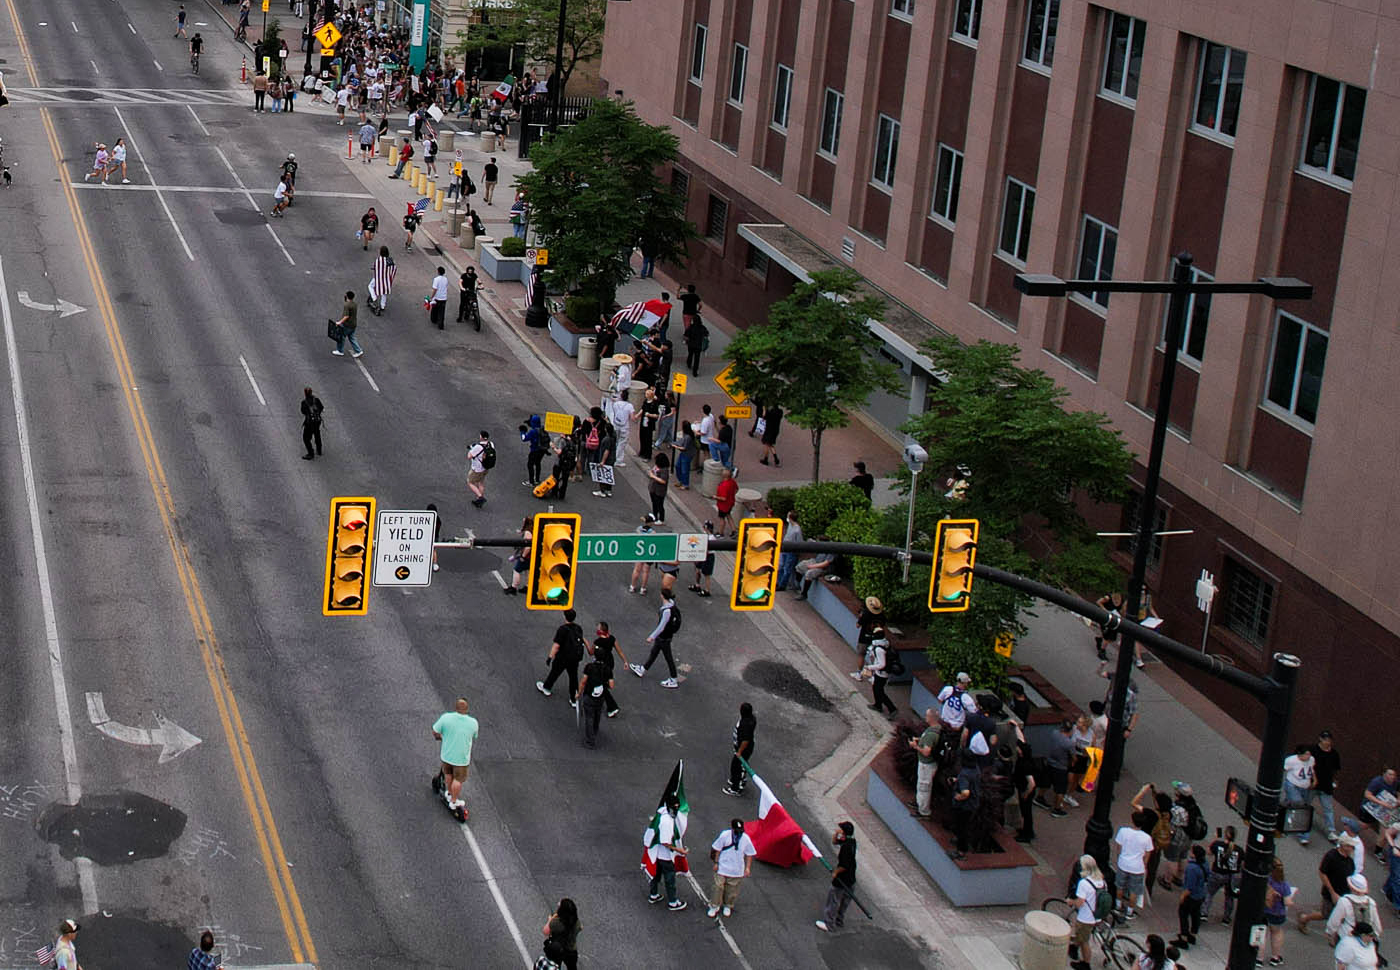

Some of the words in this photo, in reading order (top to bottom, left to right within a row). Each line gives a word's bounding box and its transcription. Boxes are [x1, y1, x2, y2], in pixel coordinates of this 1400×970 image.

[383, 516, 404, 525] LEFT
[409, 516, 431, 525] TURN
[389, 528, 424, 540] YIELD
[399, 543, 411, 552] ON
[586, 540, 619, 556] 100
[383, 554, 424, 563] FLASHING
[1298, 765, 1313, 779] 44
